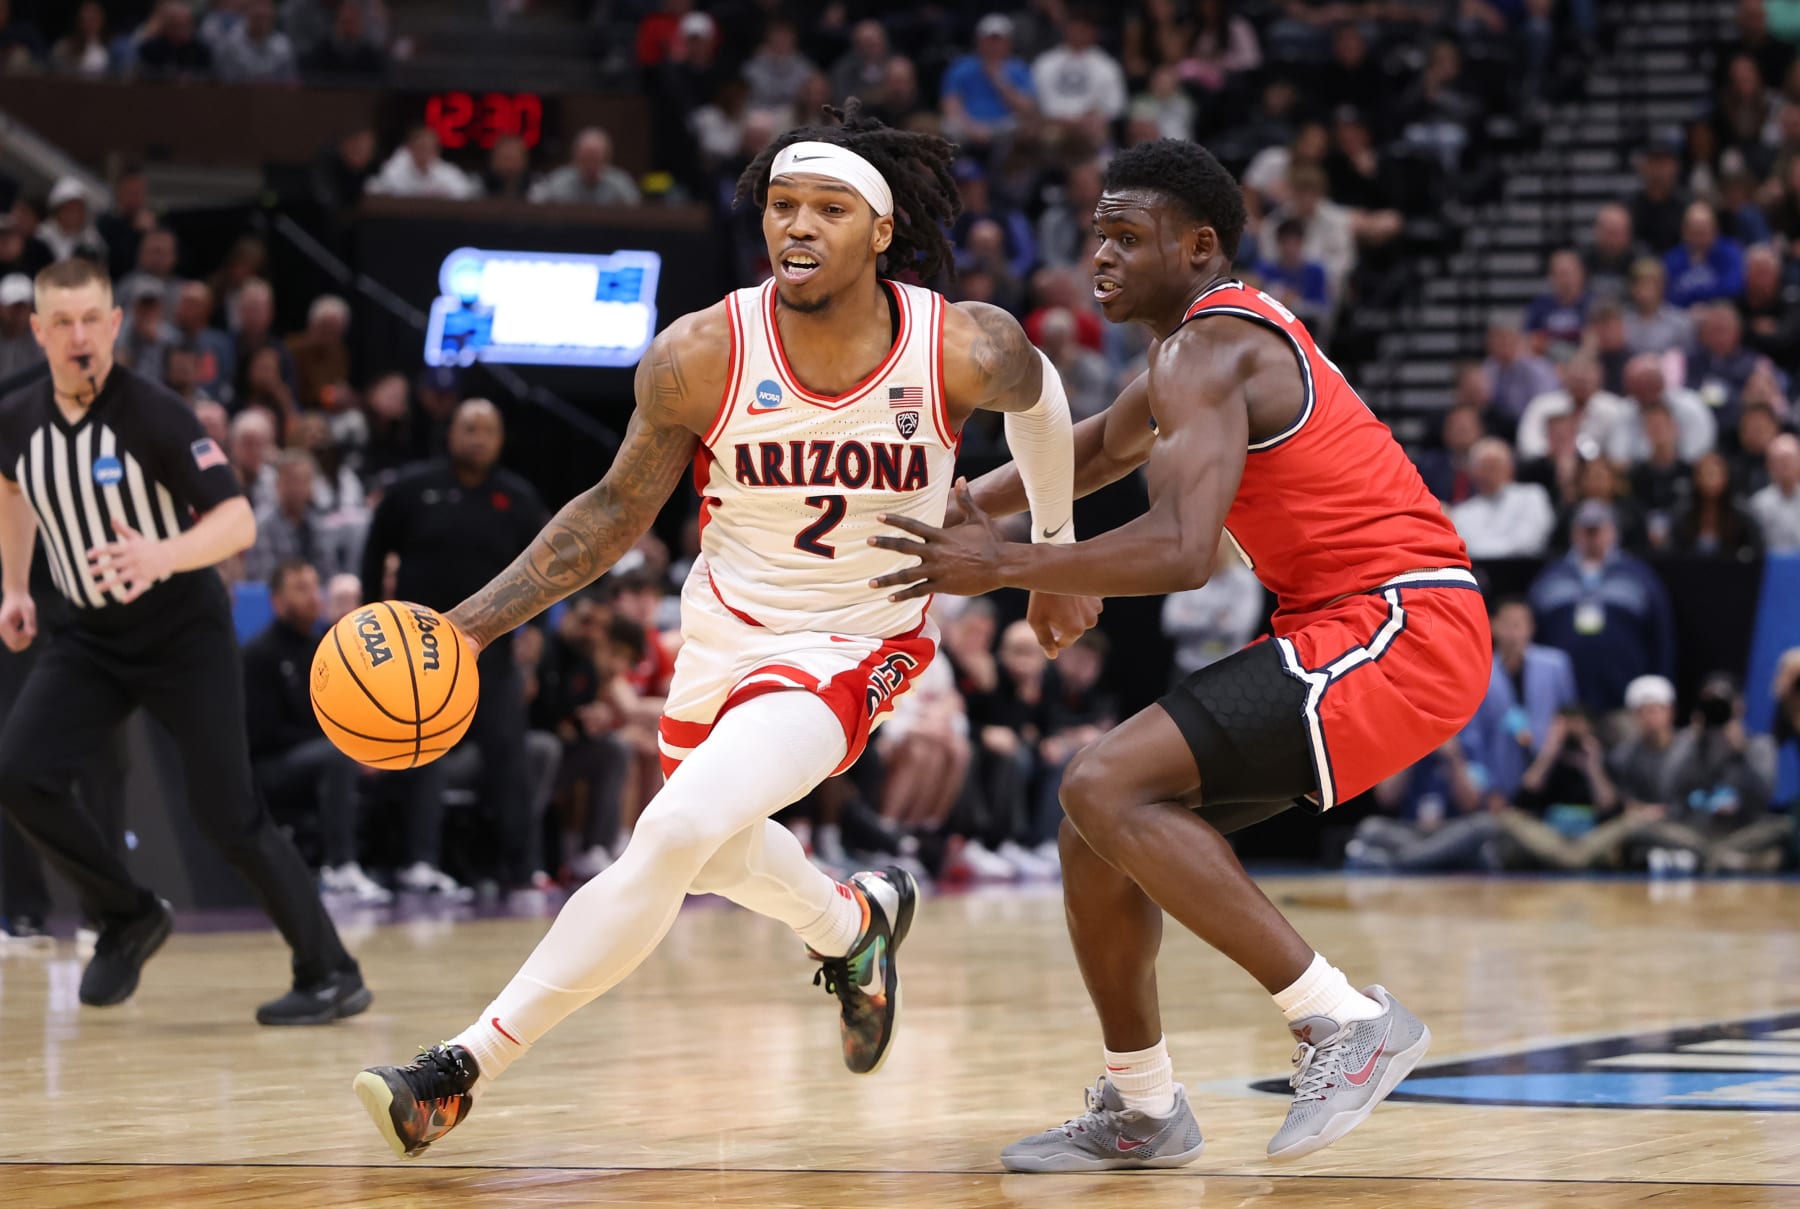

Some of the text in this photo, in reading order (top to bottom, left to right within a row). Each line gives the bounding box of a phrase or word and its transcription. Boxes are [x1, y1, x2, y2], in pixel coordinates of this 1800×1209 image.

[898, 412, 918, 429] PAC
[902, 423, 914, 434] 12
[734, 440, 929, 492] ARIZONA
[794, 494, 848, 559] 2
[353, 609, 393, 668] NCAA
